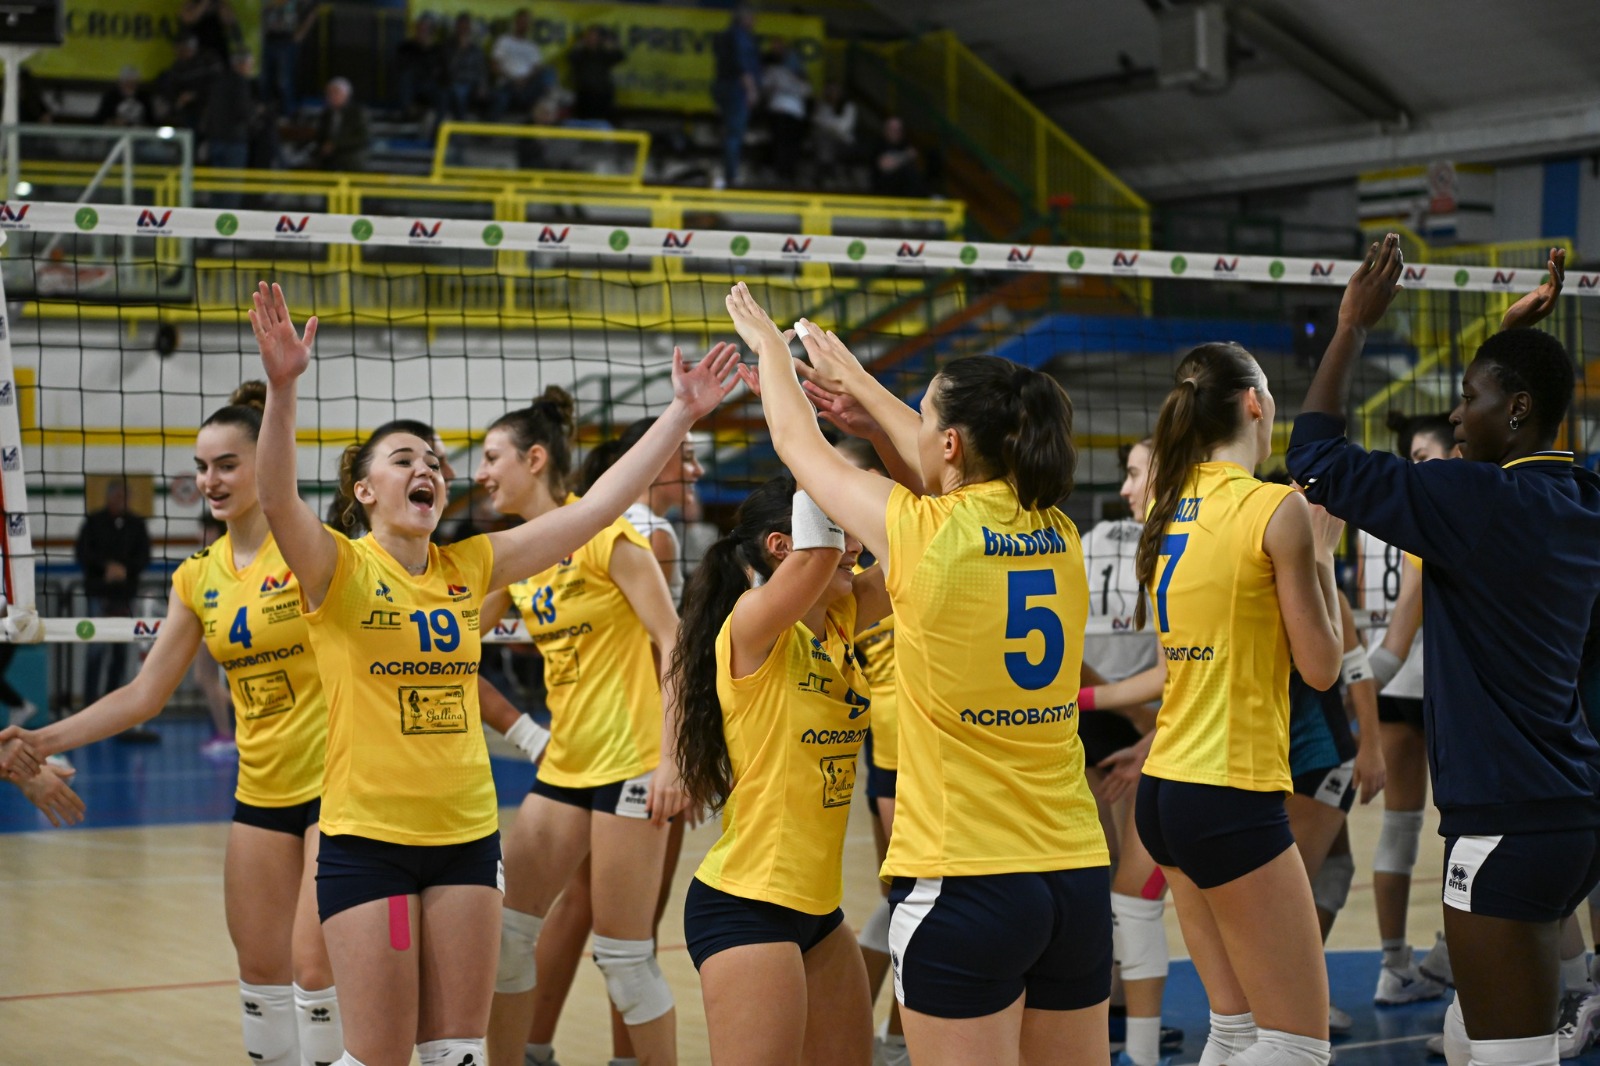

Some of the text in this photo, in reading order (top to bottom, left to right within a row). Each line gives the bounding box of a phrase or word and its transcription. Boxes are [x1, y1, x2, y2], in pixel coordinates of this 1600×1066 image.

[1102, 564, 1113, 615] 1
[1157, 533, 1189, 633] 7
[532, 586, 556, 625] 13
[229, 606, 252, 649] 4
[409, 608, 460, 652] 19
[1004, 568, 1064, 690] 5
[220, 643, 304, 670] CROBATICA
[426, 706, 463, 723] Gallina
[960, 701, 1078, 726] ACROBATIC
